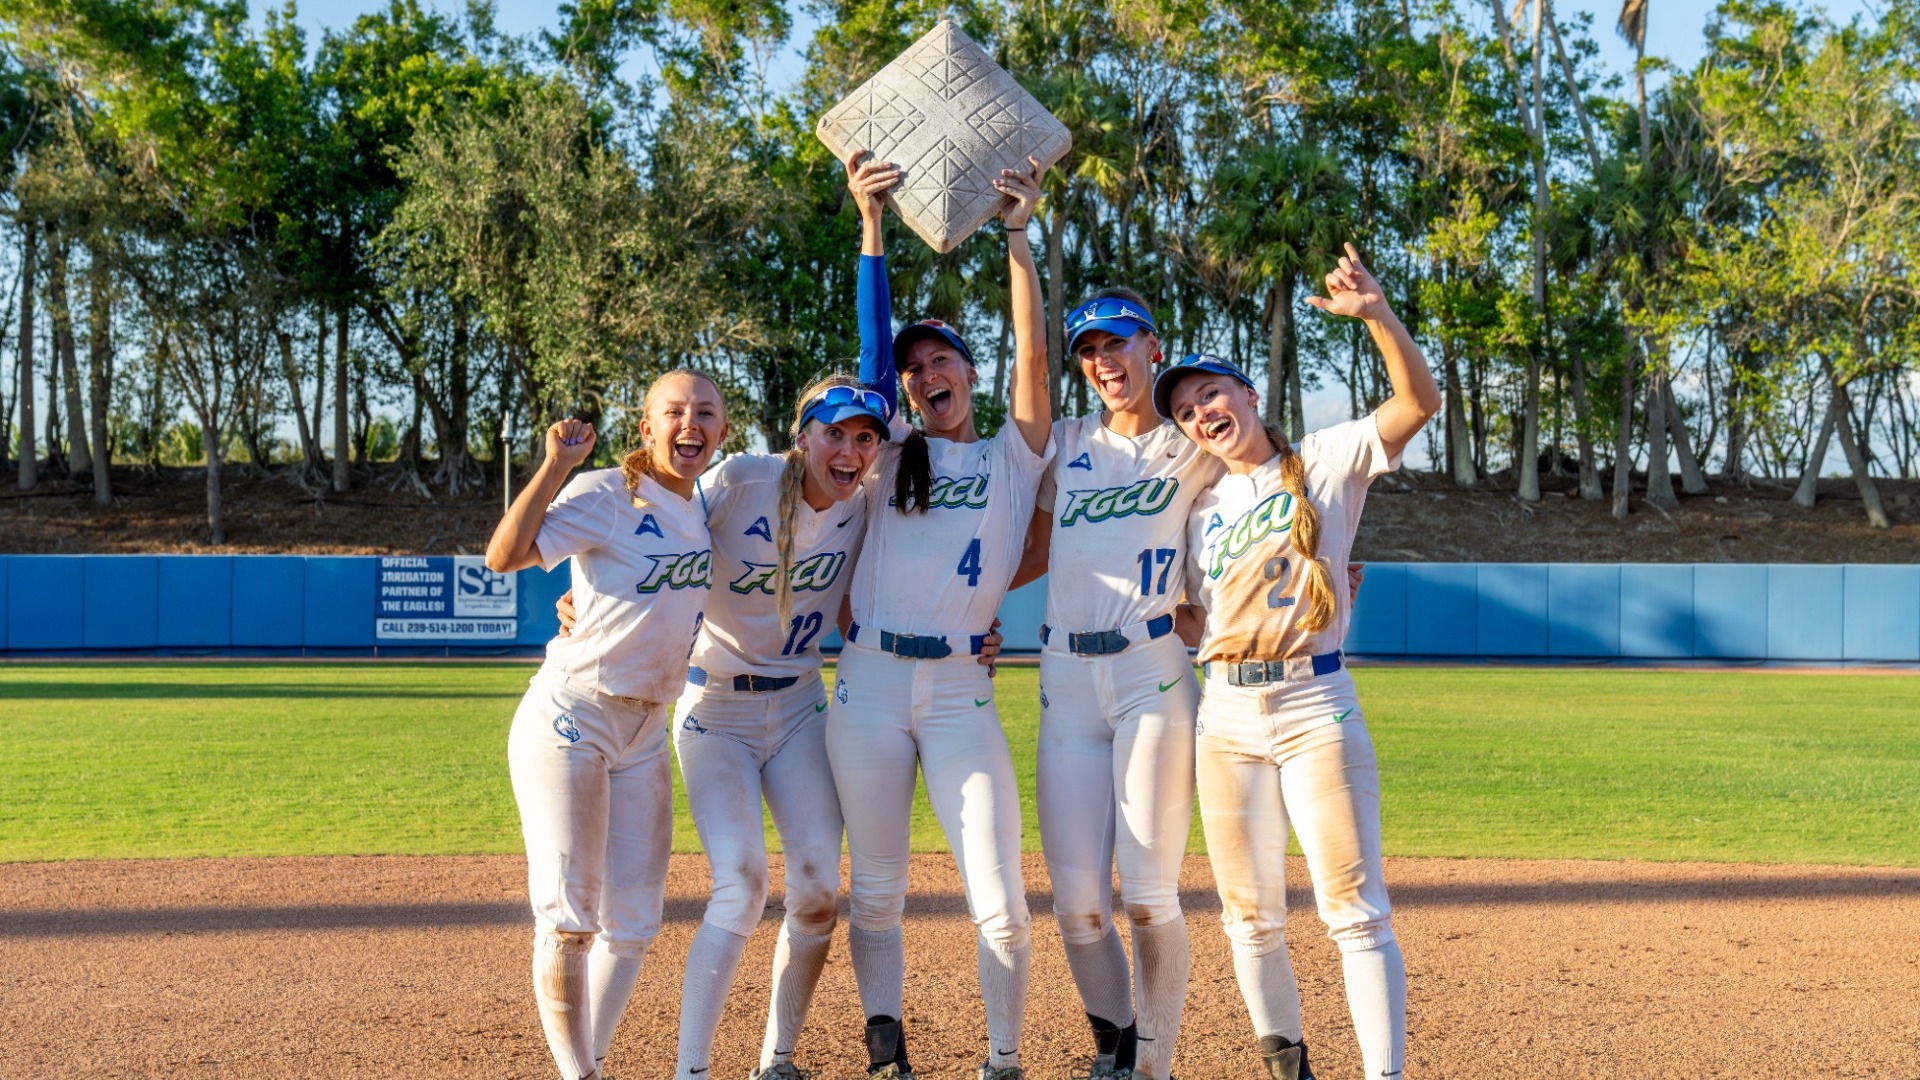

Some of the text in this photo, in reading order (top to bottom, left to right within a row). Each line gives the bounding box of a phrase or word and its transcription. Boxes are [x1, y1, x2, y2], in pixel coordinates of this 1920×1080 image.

[889, 473, 990, 509] GCU
[1060, 477, 1179, 527] FGCU
[1208, 491, 1297, 580] FGCU
[382, 558, 429, 568] OFFICIAL
[382, 572, 444, 583] IRRIGATION
[957, 538, 981, 586] 4
[1137, 548, 1176, 595] 17
[1263, 556, 1295, 608] 2
[382, 586, 443, 597] PARTNER OF
[382, 601, 445, 612] THE EAGLES!
[382, 622, 511, 633] CALL 239-514-1200 TODAY!
[782, 611, 823, 656] 12
